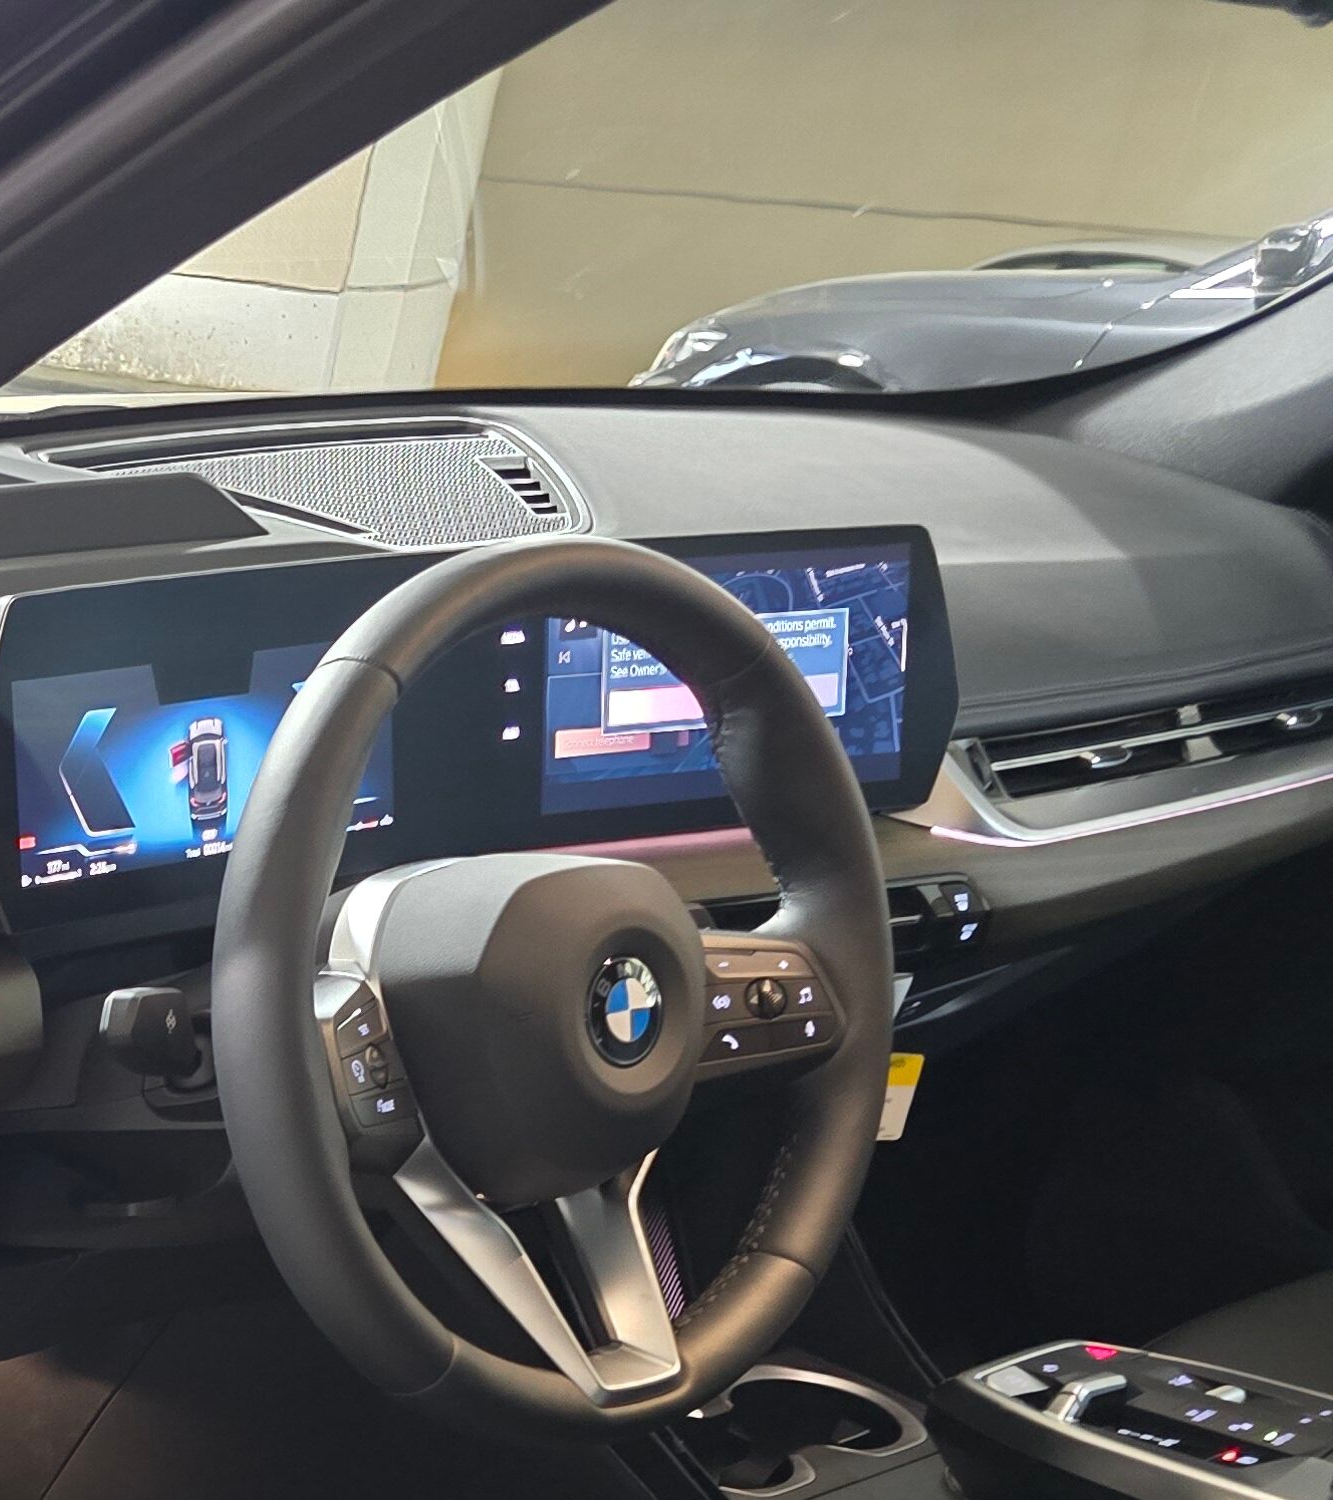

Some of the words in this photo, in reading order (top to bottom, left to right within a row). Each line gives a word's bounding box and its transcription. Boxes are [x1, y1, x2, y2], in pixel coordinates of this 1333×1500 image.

[766, 619, 804, 633] nditions
[804, 616, 837, 633] permit.
[610, 648, 631, 662] Safe
[776, 633, 833, 651] sponsibility.
[610, 666, 629, 679] See
[595, 735, 635, 747] telephone
